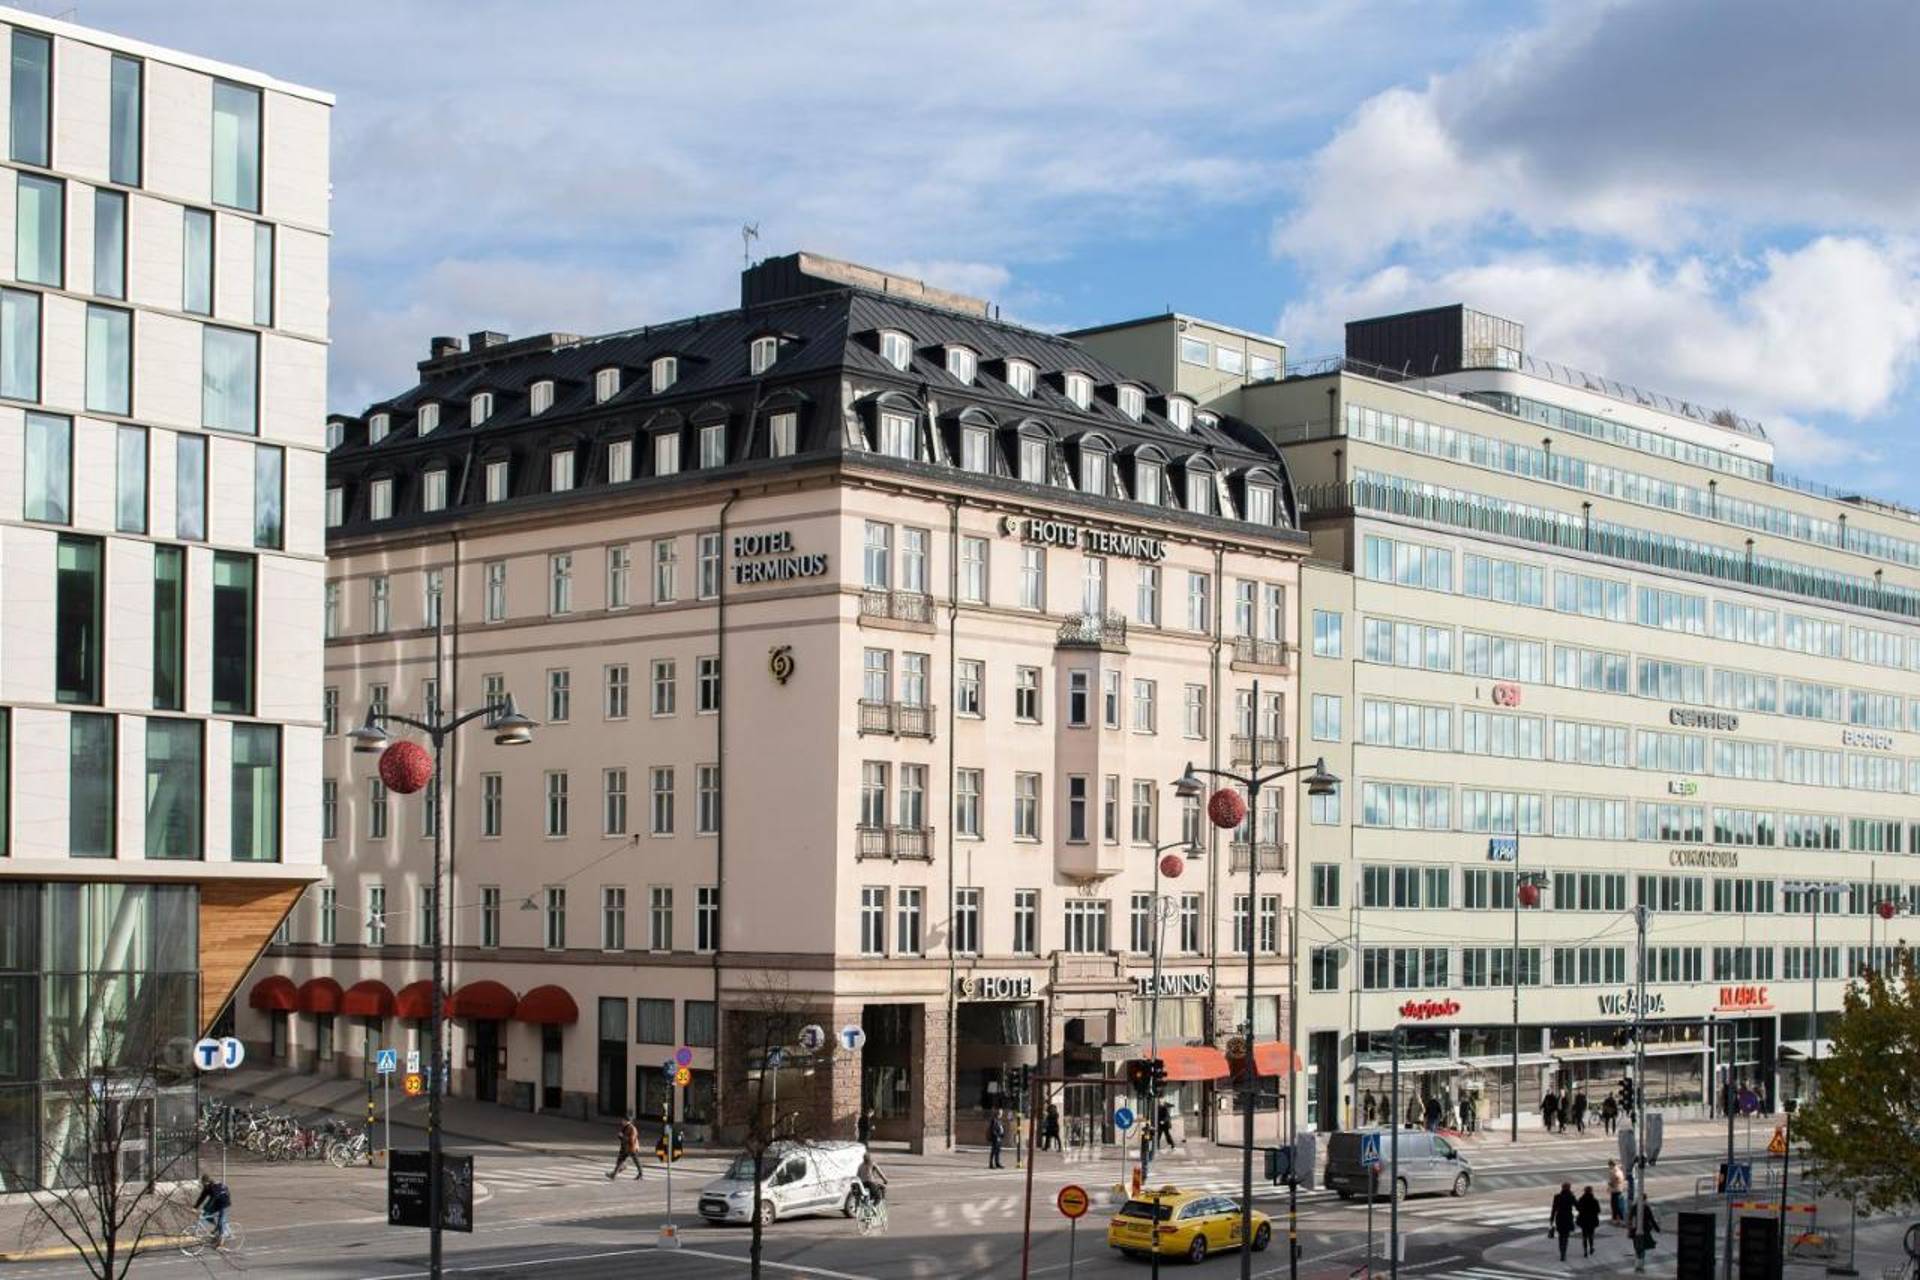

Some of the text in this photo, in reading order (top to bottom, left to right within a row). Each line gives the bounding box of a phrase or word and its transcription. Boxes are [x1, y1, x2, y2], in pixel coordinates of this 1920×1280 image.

[733, 531, 794, 557] HOTEL
[1029, 519, 1167, 560] HOTEL TERMINUS
[730, 553, 828, 584] TERMINUS
[983, 974, 1211, 998] HOTEL TERMINUS
[1759, 985, 1769, 1005] C
[843, 1030, 860, 1048] T
[199, 1041, 236, 1066] T J
